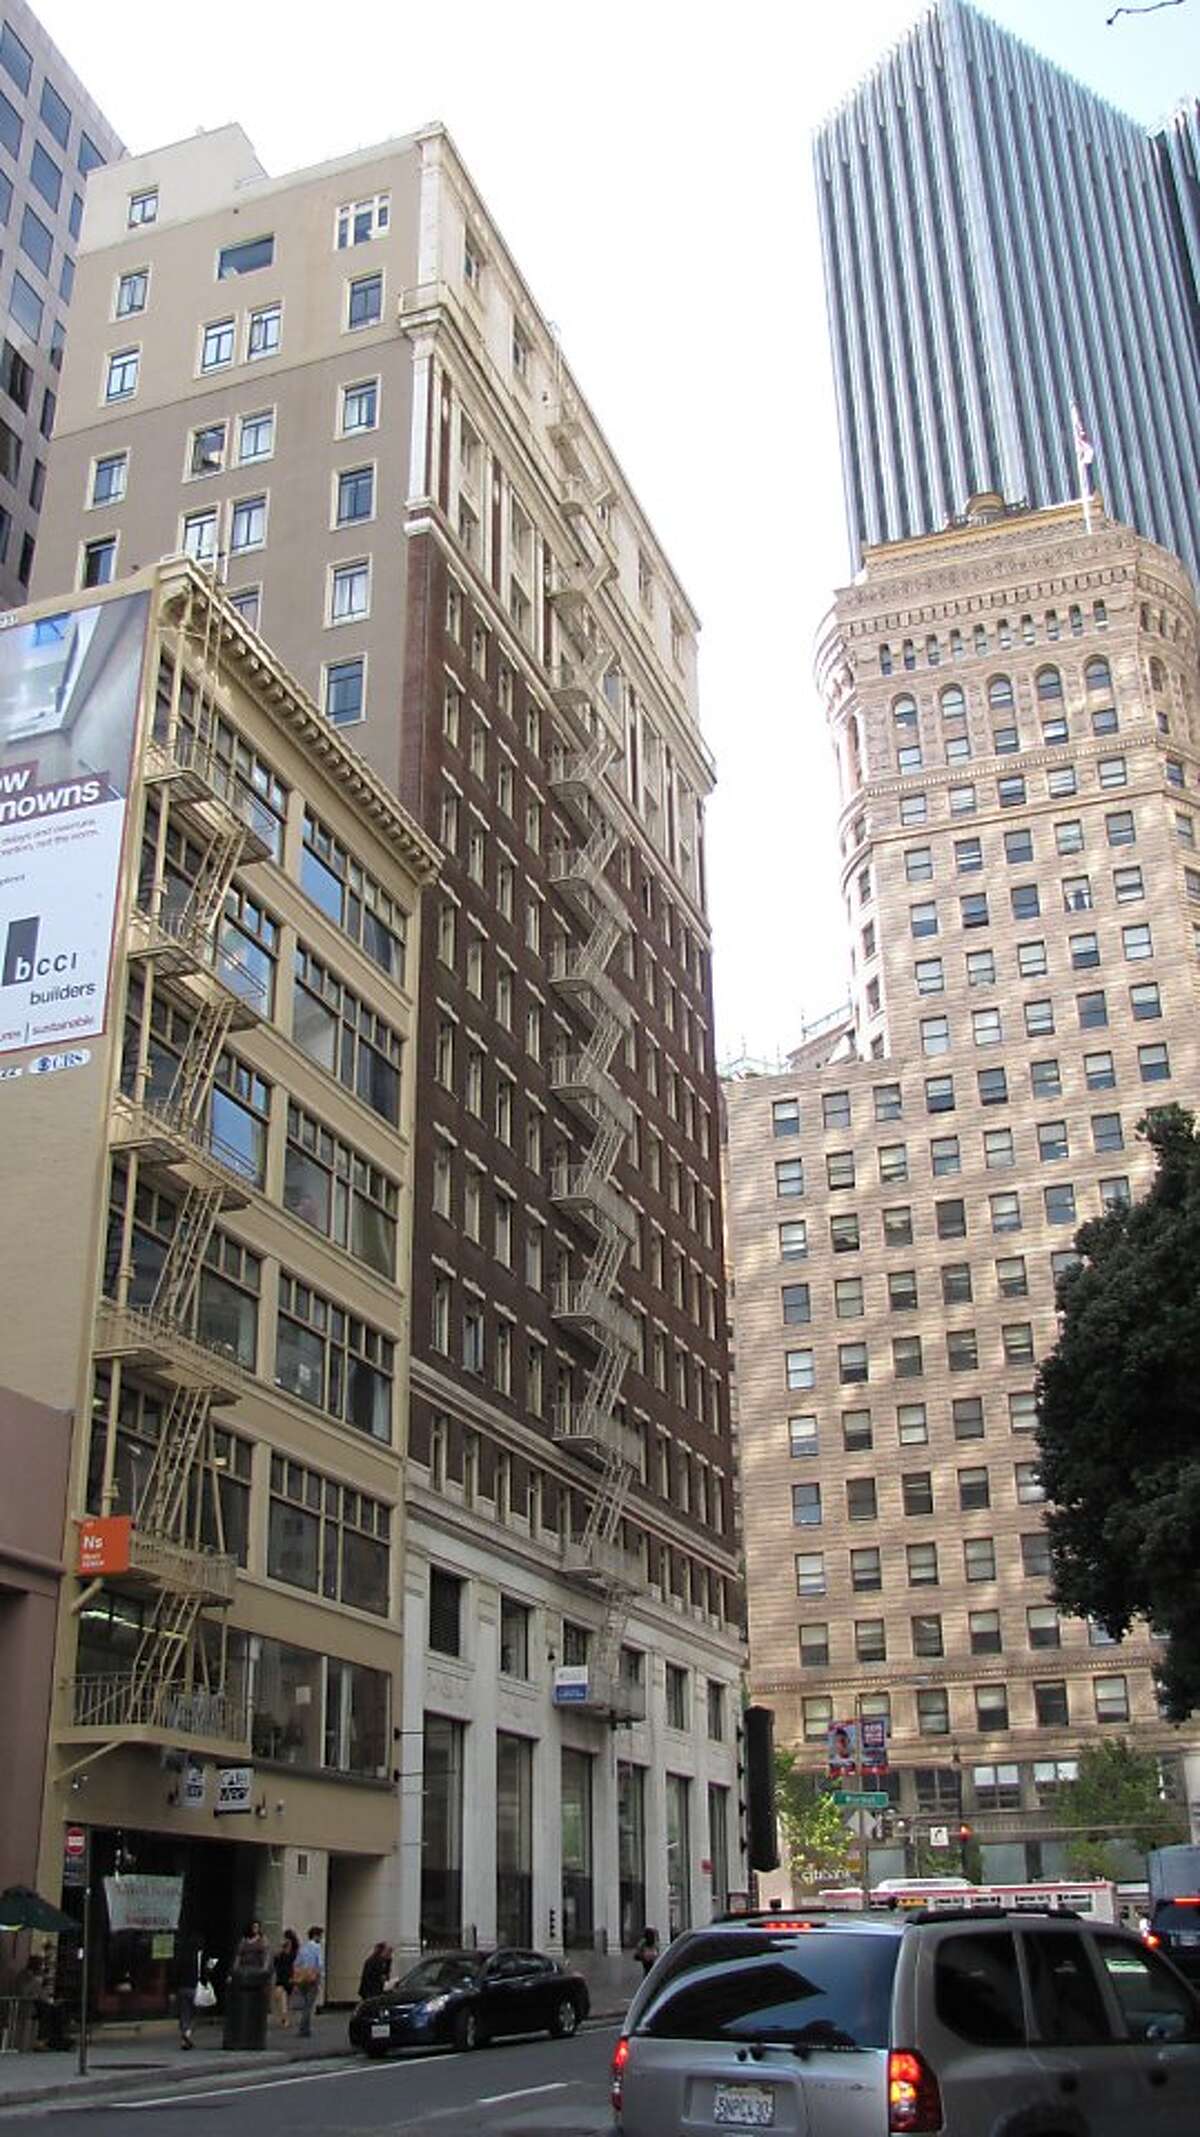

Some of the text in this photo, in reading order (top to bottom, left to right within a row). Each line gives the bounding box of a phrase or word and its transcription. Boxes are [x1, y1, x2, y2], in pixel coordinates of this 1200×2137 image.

[0, 770, 31, 793] w
[30, 983, 96, 1005] builders
[84, 1536, 103, 1549] Ns
